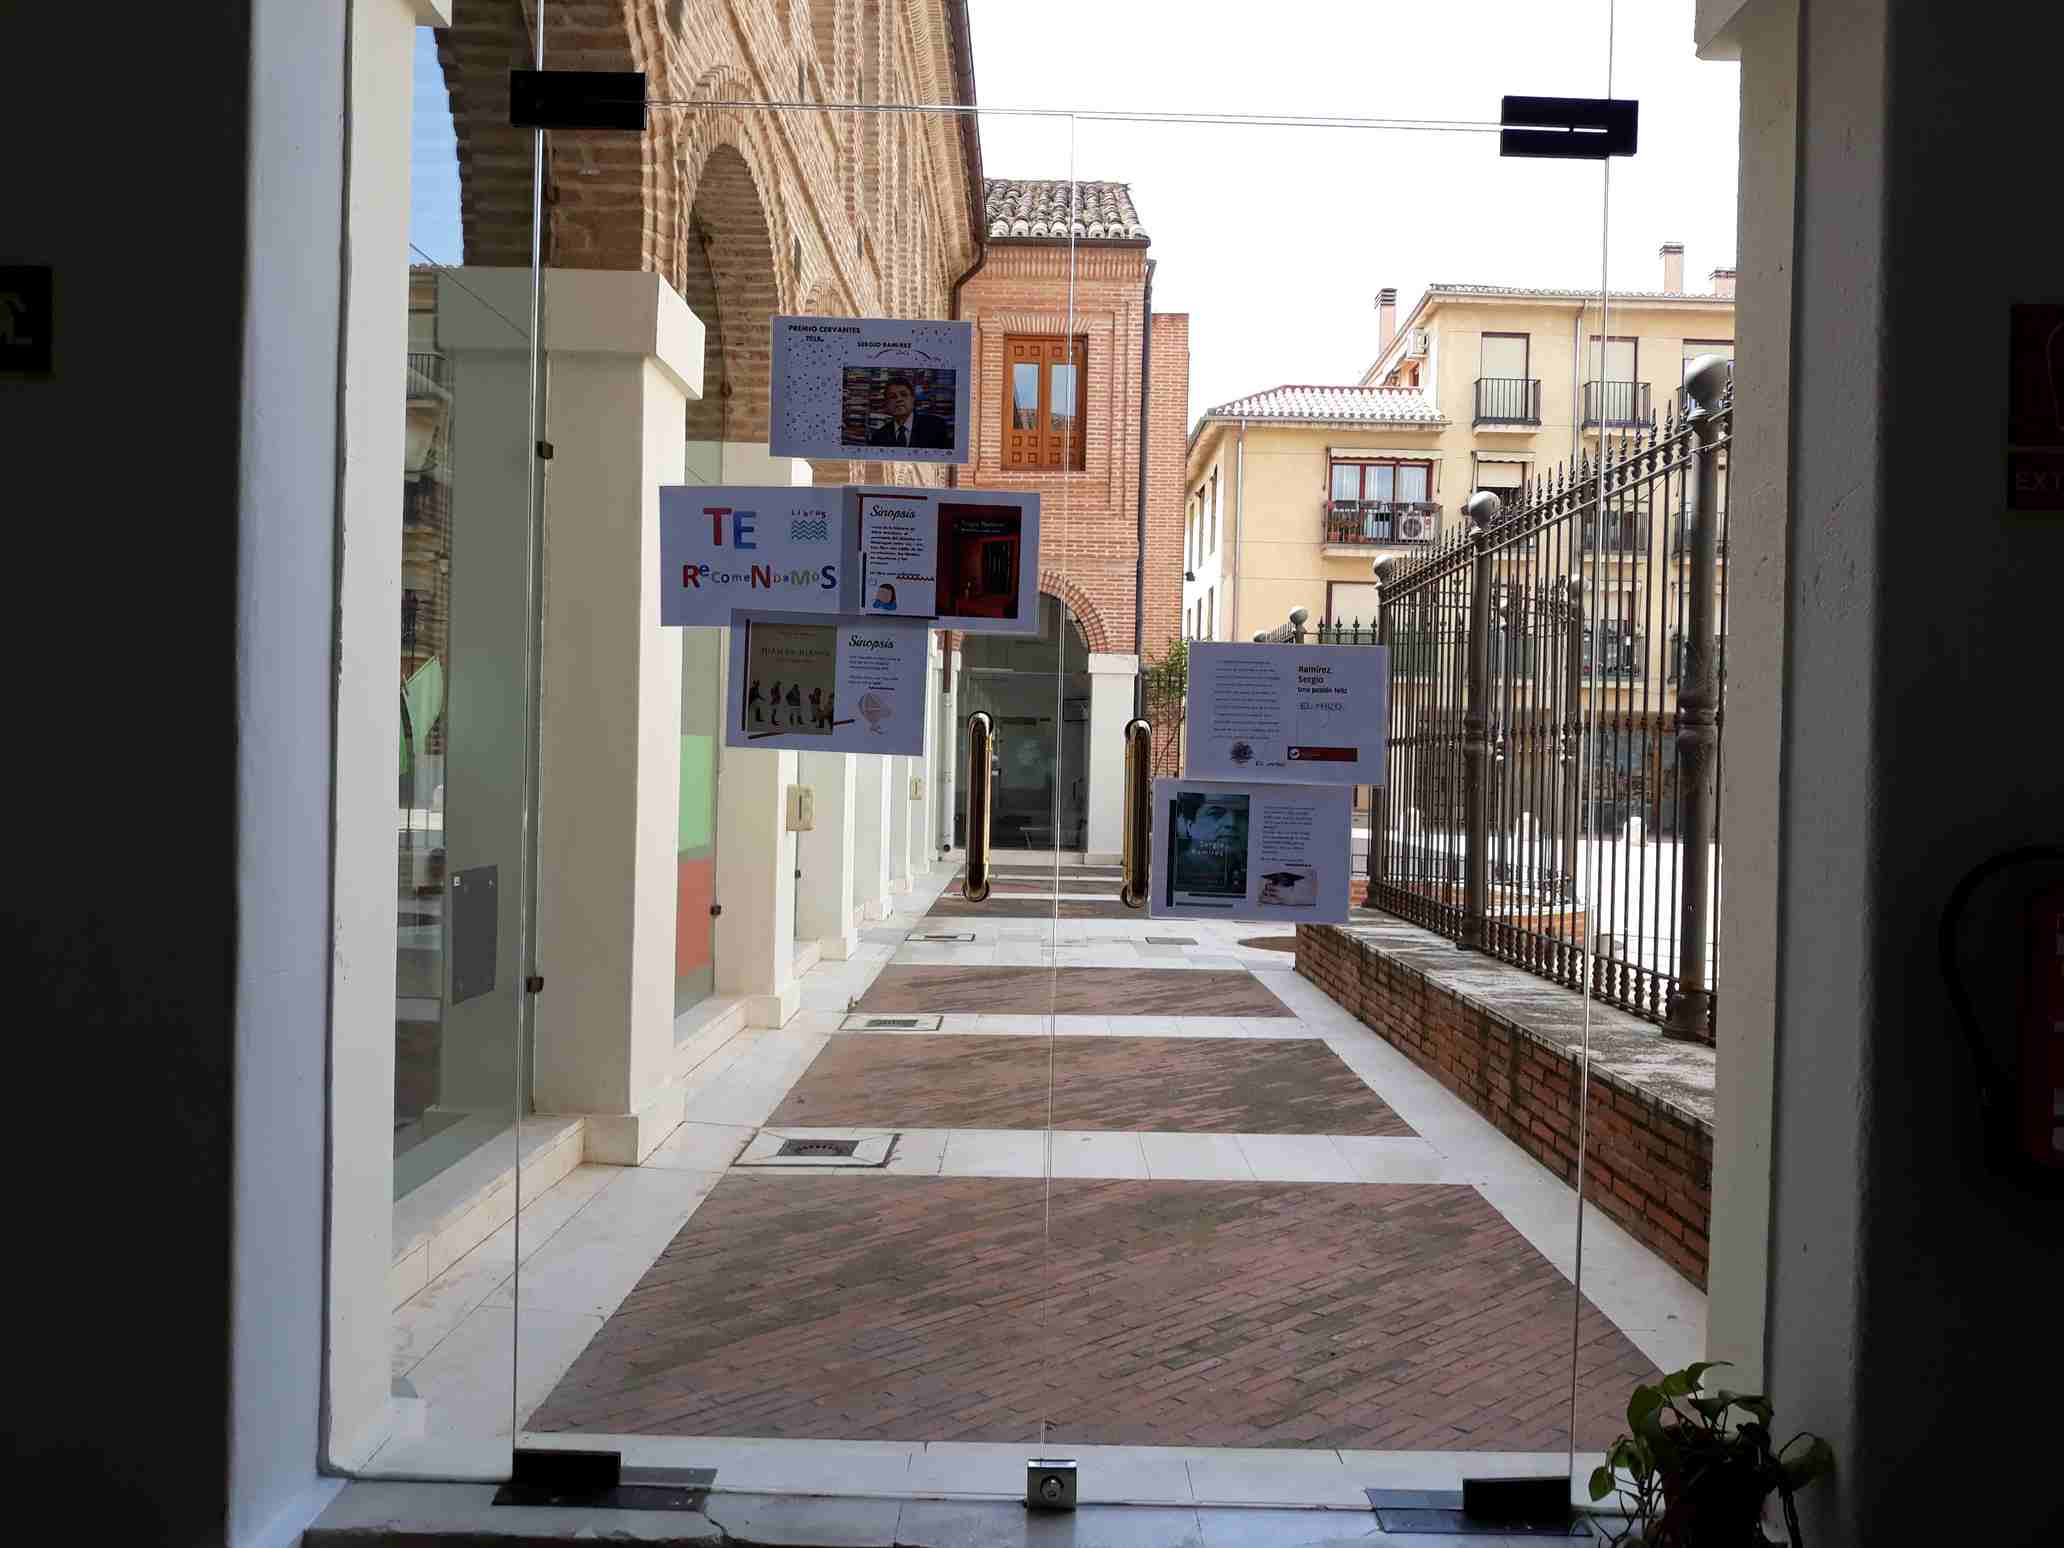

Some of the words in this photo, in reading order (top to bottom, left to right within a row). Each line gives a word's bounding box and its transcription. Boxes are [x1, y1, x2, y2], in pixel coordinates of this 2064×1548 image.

[787, 324, 818, 333] PREMIO
[818, 325, 861, 335] CERVANTES
[870, 504, 916, 521] Sinopsis
[703, 507, 757, 550] TE
[848, 633, 895, 651] Sinopsis
[1298, 675, 1325, 685] Sergio
